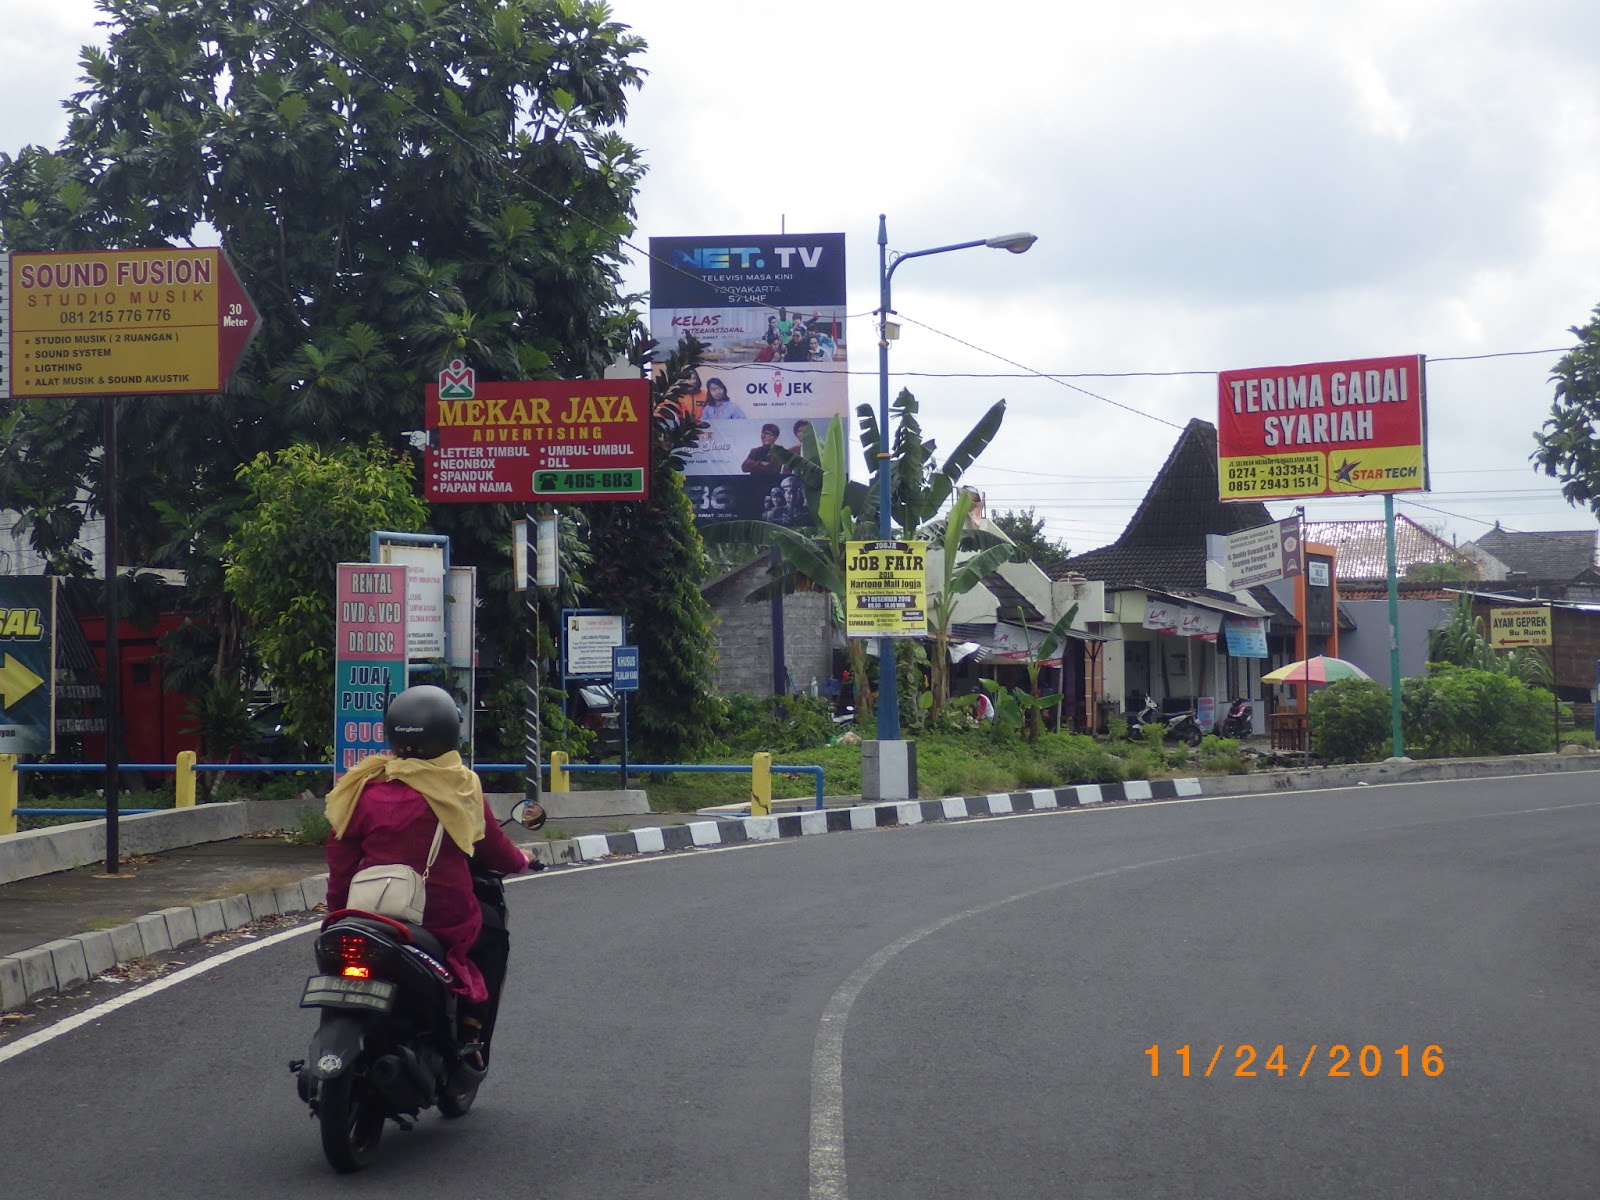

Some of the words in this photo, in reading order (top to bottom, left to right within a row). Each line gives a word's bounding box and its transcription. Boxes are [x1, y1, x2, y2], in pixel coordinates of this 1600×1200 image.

[672, 247, 765, 269] NET.
[774, 246, 823, 268] TV
[20, 262, 108, 289] SOUND
[117, 258, 211, 286] FUSION
[702, 274, 743, 282] TELEVISI
[28, 292, 116, 307] STUDIO
[130, 289, 204, 304] MUSIK
[60, 311, 84, 324] 081
[89, 310, 113, 323] 215
[118, 309, 142, 322] 776
[146, 308, 171, 321] 776
[229, 304, 242, 315] 30
[223, 316, 248, 327] Meter
[671, 314, 721, 326] KELAS
[35, 336, 72, 345] STUDIO
[75, 335, 106, 344] MUSIK
[124, 333, 172, 343] RUANGAN
[35, 350, 69, 359] SOUND
[72, 349, 111, 358] SYSTEM
[35, 363, 82, 372] LIGTHING
[35, 378, 60, 386] ALAT
[63, 376, 94, 386] MUSIK
[98, 376, 104, 385] &
[108, 375, 142, 384] SOUND
[145, 374, 189, 383] AKUSTIK
[746, 383, 768, 394] OK
[785, 383, 813, 397] JEK
[1230, 374, 1325, 414] TERIMA
[1330, 368, 1407, 406] GADAI
[437, 398, 552, 427] MEKAR
[561, 396, 638, 424] JAYA
[473, 427, 602, 442] ADVERTISING
[1264, 410, 1373, 446] SYARIAH
[440, 447, 483, 458] LETTER
[487, 446, 530, 457] TIMBUL
[440, 459, 495, 470] NEONBOX
[548, 458, 569, 468] DLL
[440, 471, 494, 481] SPANDUK
[1229, 465, 1257, 479] 0274
[1268, 463, 1319, 477] 4333441
[440, 482, 477, 493] PAPAN
[479, 482, 513, 492] NAMA
[564, 473, 633, 488] 485-683
[1229, 480, 1257, 492] 0857
[1260, 478, 1289, 490] 2943
[1293, 477, 1319, 488] 1514
[848, 556, 879, 571] JOB
[885, 556, 924, 571] FAIR
[879, 571, 894, 579] 2016
[352, 573, 392, 594] RENTAL
[850, 580, 882, 588] Hartono
[884, 580, 900, 588] Mall
[901, 580, 921, 589] Jogja
[342, 602, 365, 623] DVD
[368, 606, 376, 623] &
[378, 602, 401, 624] VCD
[1493, 618, 1514, 628] AYAM
[1516, 616, 1547, 627] GEPREK
[367, 631, 395, 653] DISC
[617, 656, 635, 667] KHUSUS
[350, 666, 392, 685] JUAL
[332, 978, 365, 992] 6642
